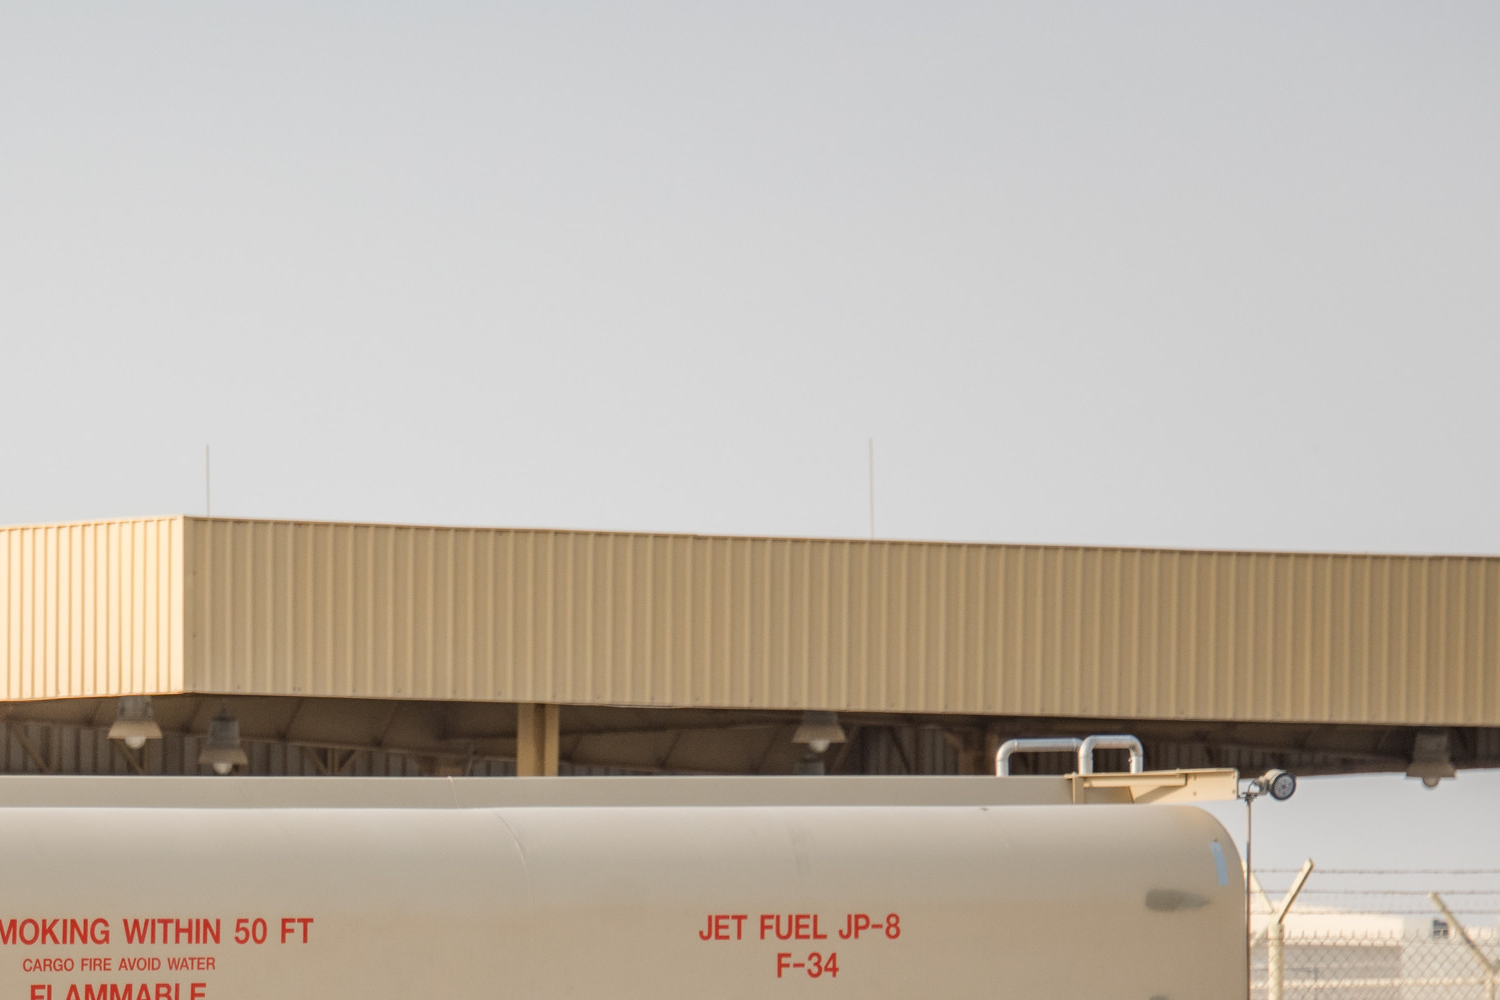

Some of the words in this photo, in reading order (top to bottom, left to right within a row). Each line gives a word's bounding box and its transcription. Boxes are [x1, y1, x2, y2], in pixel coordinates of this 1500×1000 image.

[122, 917, 221, 945] WITHIN
[233, 917, 268, 945] 50
[280, 917, 315, 945] FT
[698, 914, 749, 941] JET
[759, 913, 828, 941] FUEL
[837, 912, 901, 940] JP-8
[22, 957, 75, 973] CARGO
[80, 957, 112, 972] FIRE
[118, 957, 162, 972] AVOID
[167, 956, 216, 971] WATER
[776, 951, 840, 979] F-34
